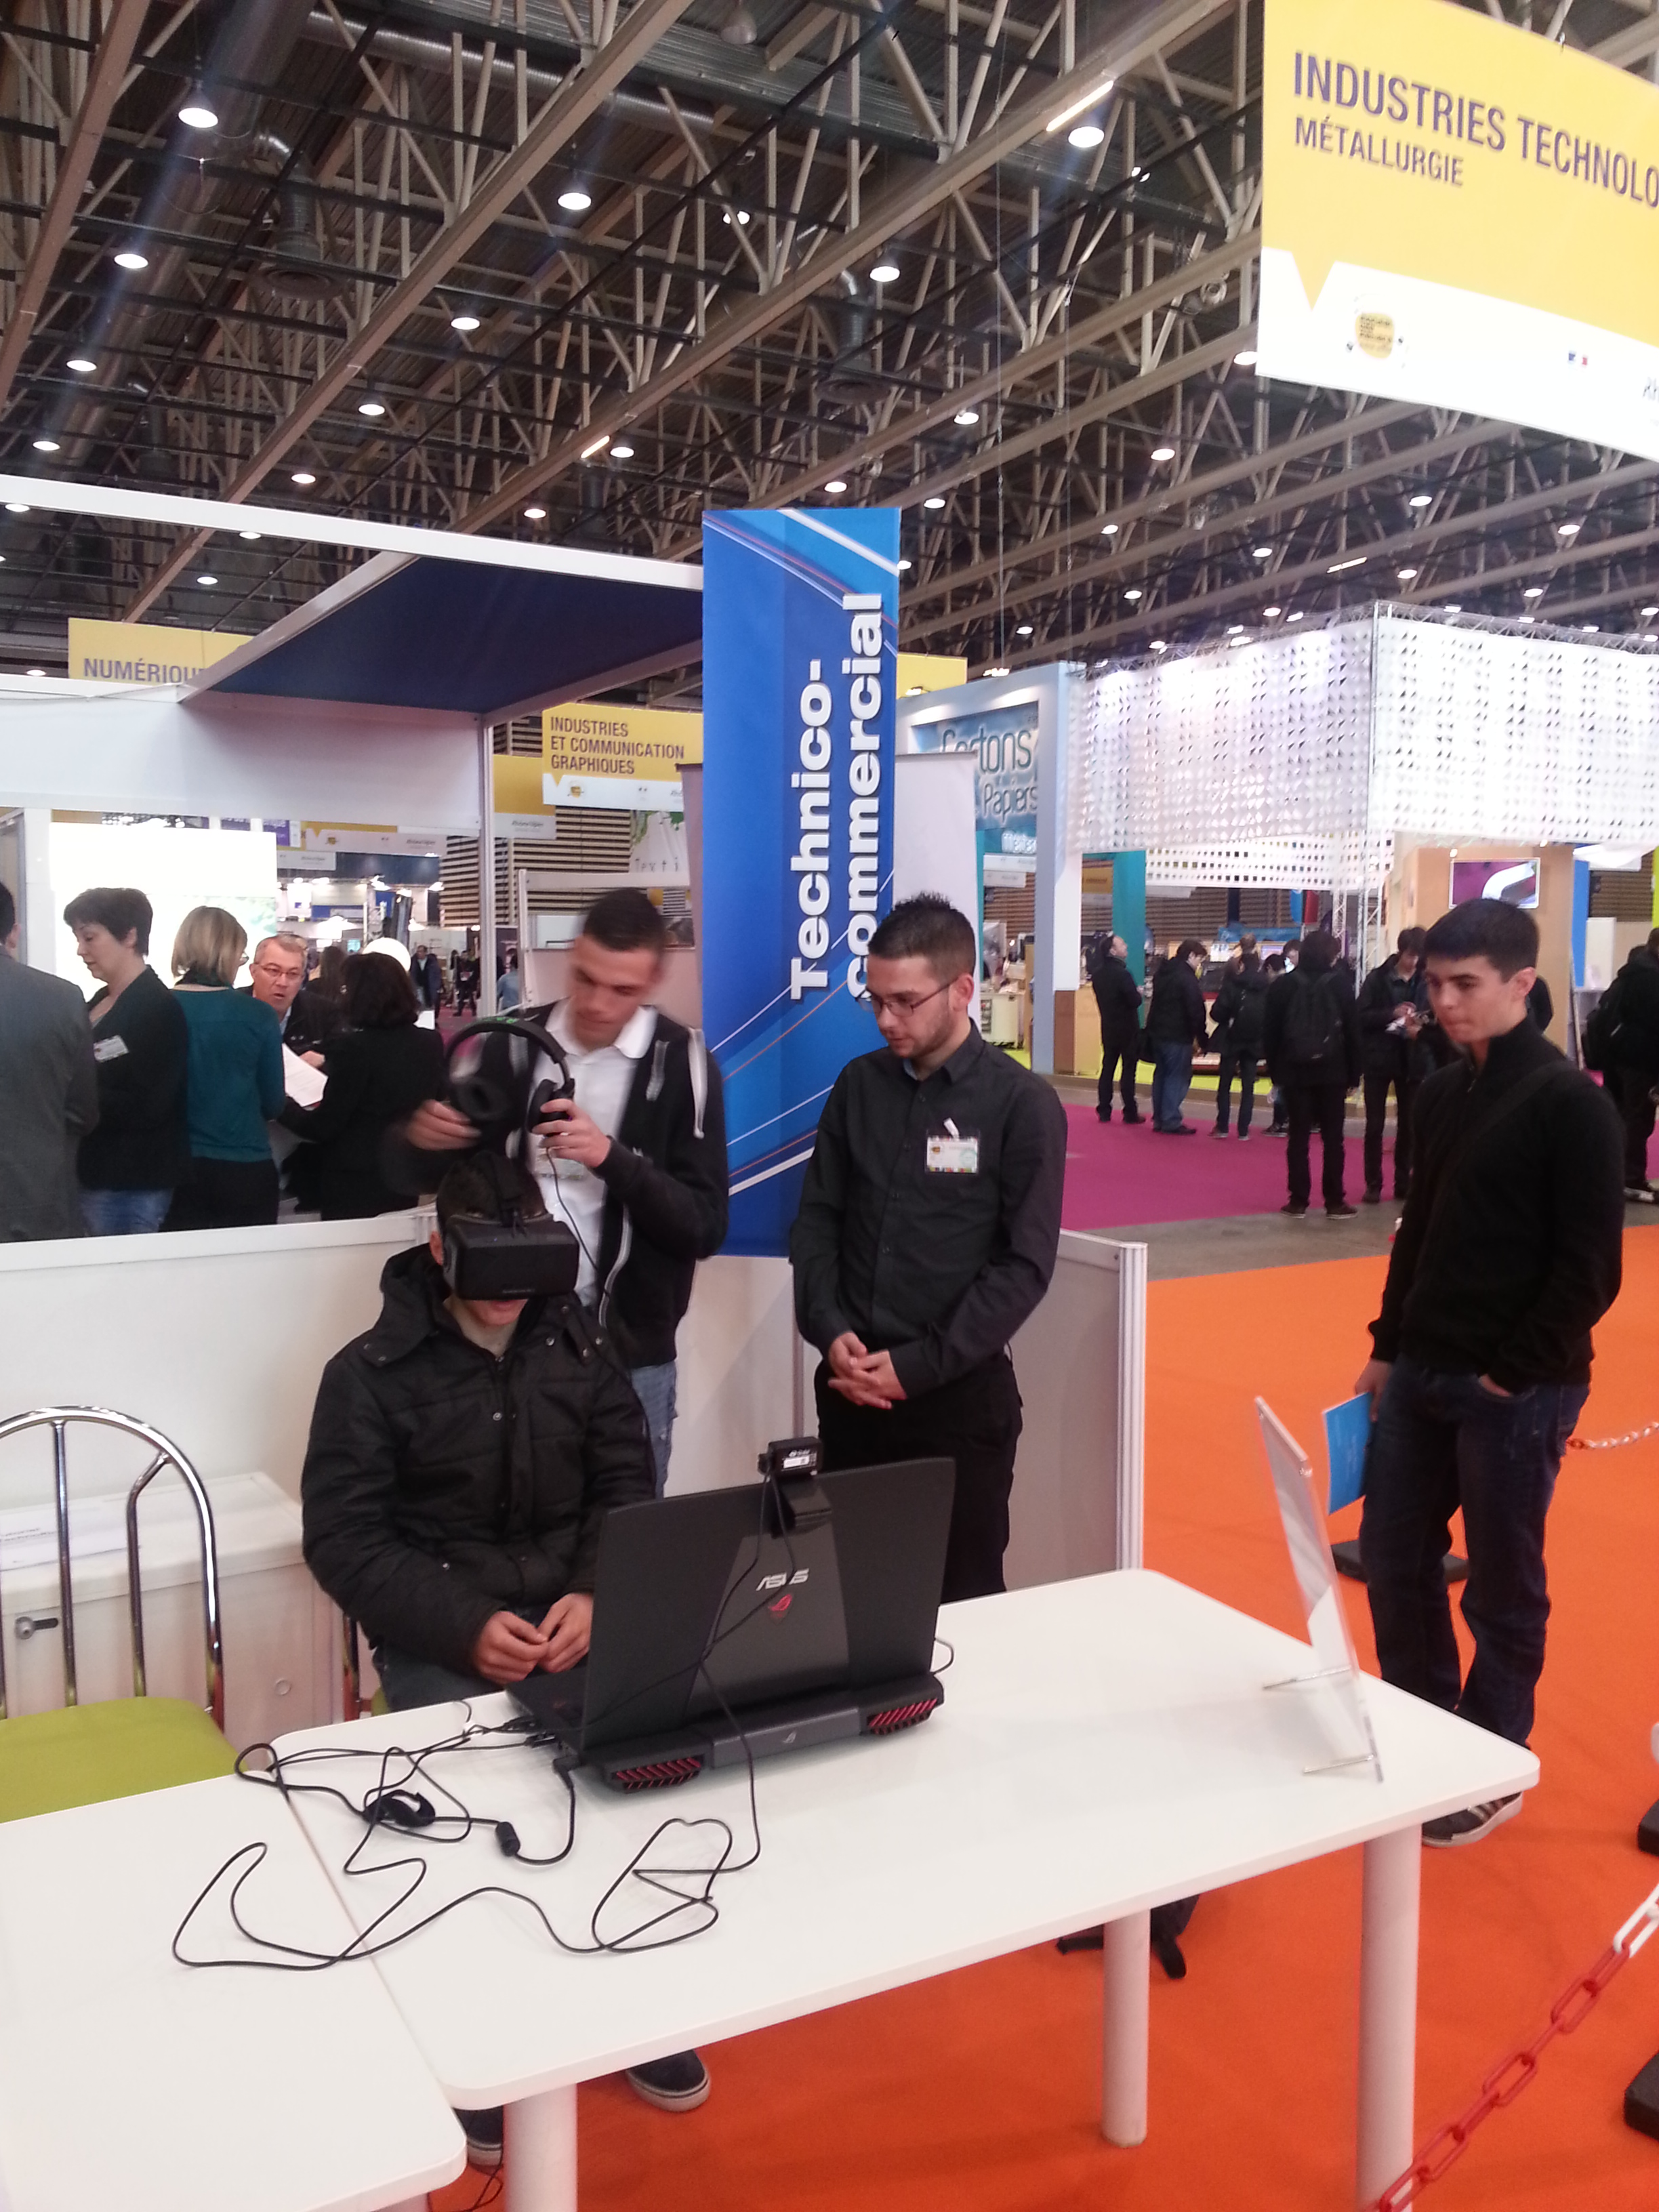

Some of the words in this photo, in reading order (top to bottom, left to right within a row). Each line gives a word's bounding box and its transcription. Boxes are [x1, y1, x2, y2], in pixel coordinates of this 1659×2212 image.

[1294, 52, 1506, 151] INDUSTRIES
[1517, 113, 1659, 209] TECHNOLO
[1295, 116, 1464, 187] MÉTALLURGIE
[83, 657, 205, 684] NUMÉRIQU
[550, 716, 629, 737] INDUSTRIES
[550, 735, 566, 751] ET
[570, 737, 684, 760] COMMUNICATION
[551, 754, 635, 775] GRAPHIQUES
[842, 593, 882, 1000] commercial
[790, 659, 832, 1000] Technico-
